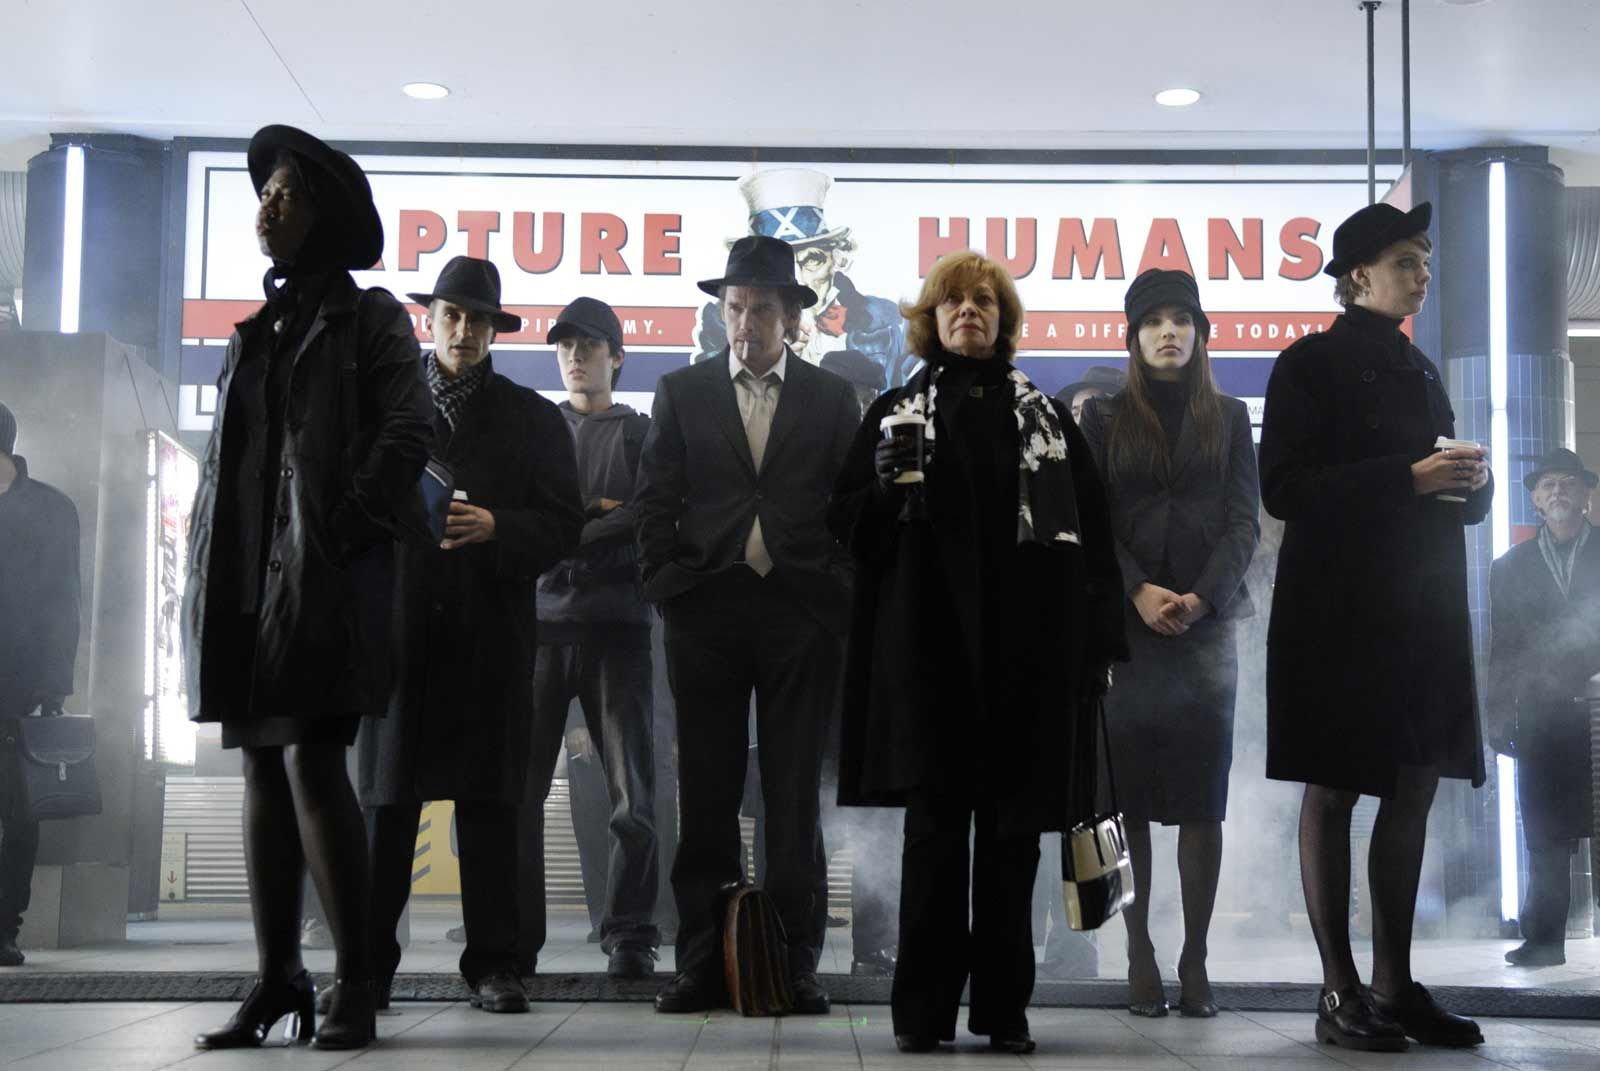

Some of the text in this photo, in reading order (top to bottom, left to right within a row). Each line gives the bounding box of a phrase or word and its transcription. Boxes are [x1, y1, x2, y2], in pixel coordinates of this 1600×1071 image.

[371, 209, 683, 276] PTURE
[918, 216, 1324, 281] HUMANS
[623, 319, 663, 335] MY.
[1046, 323, 1057, 339] A
